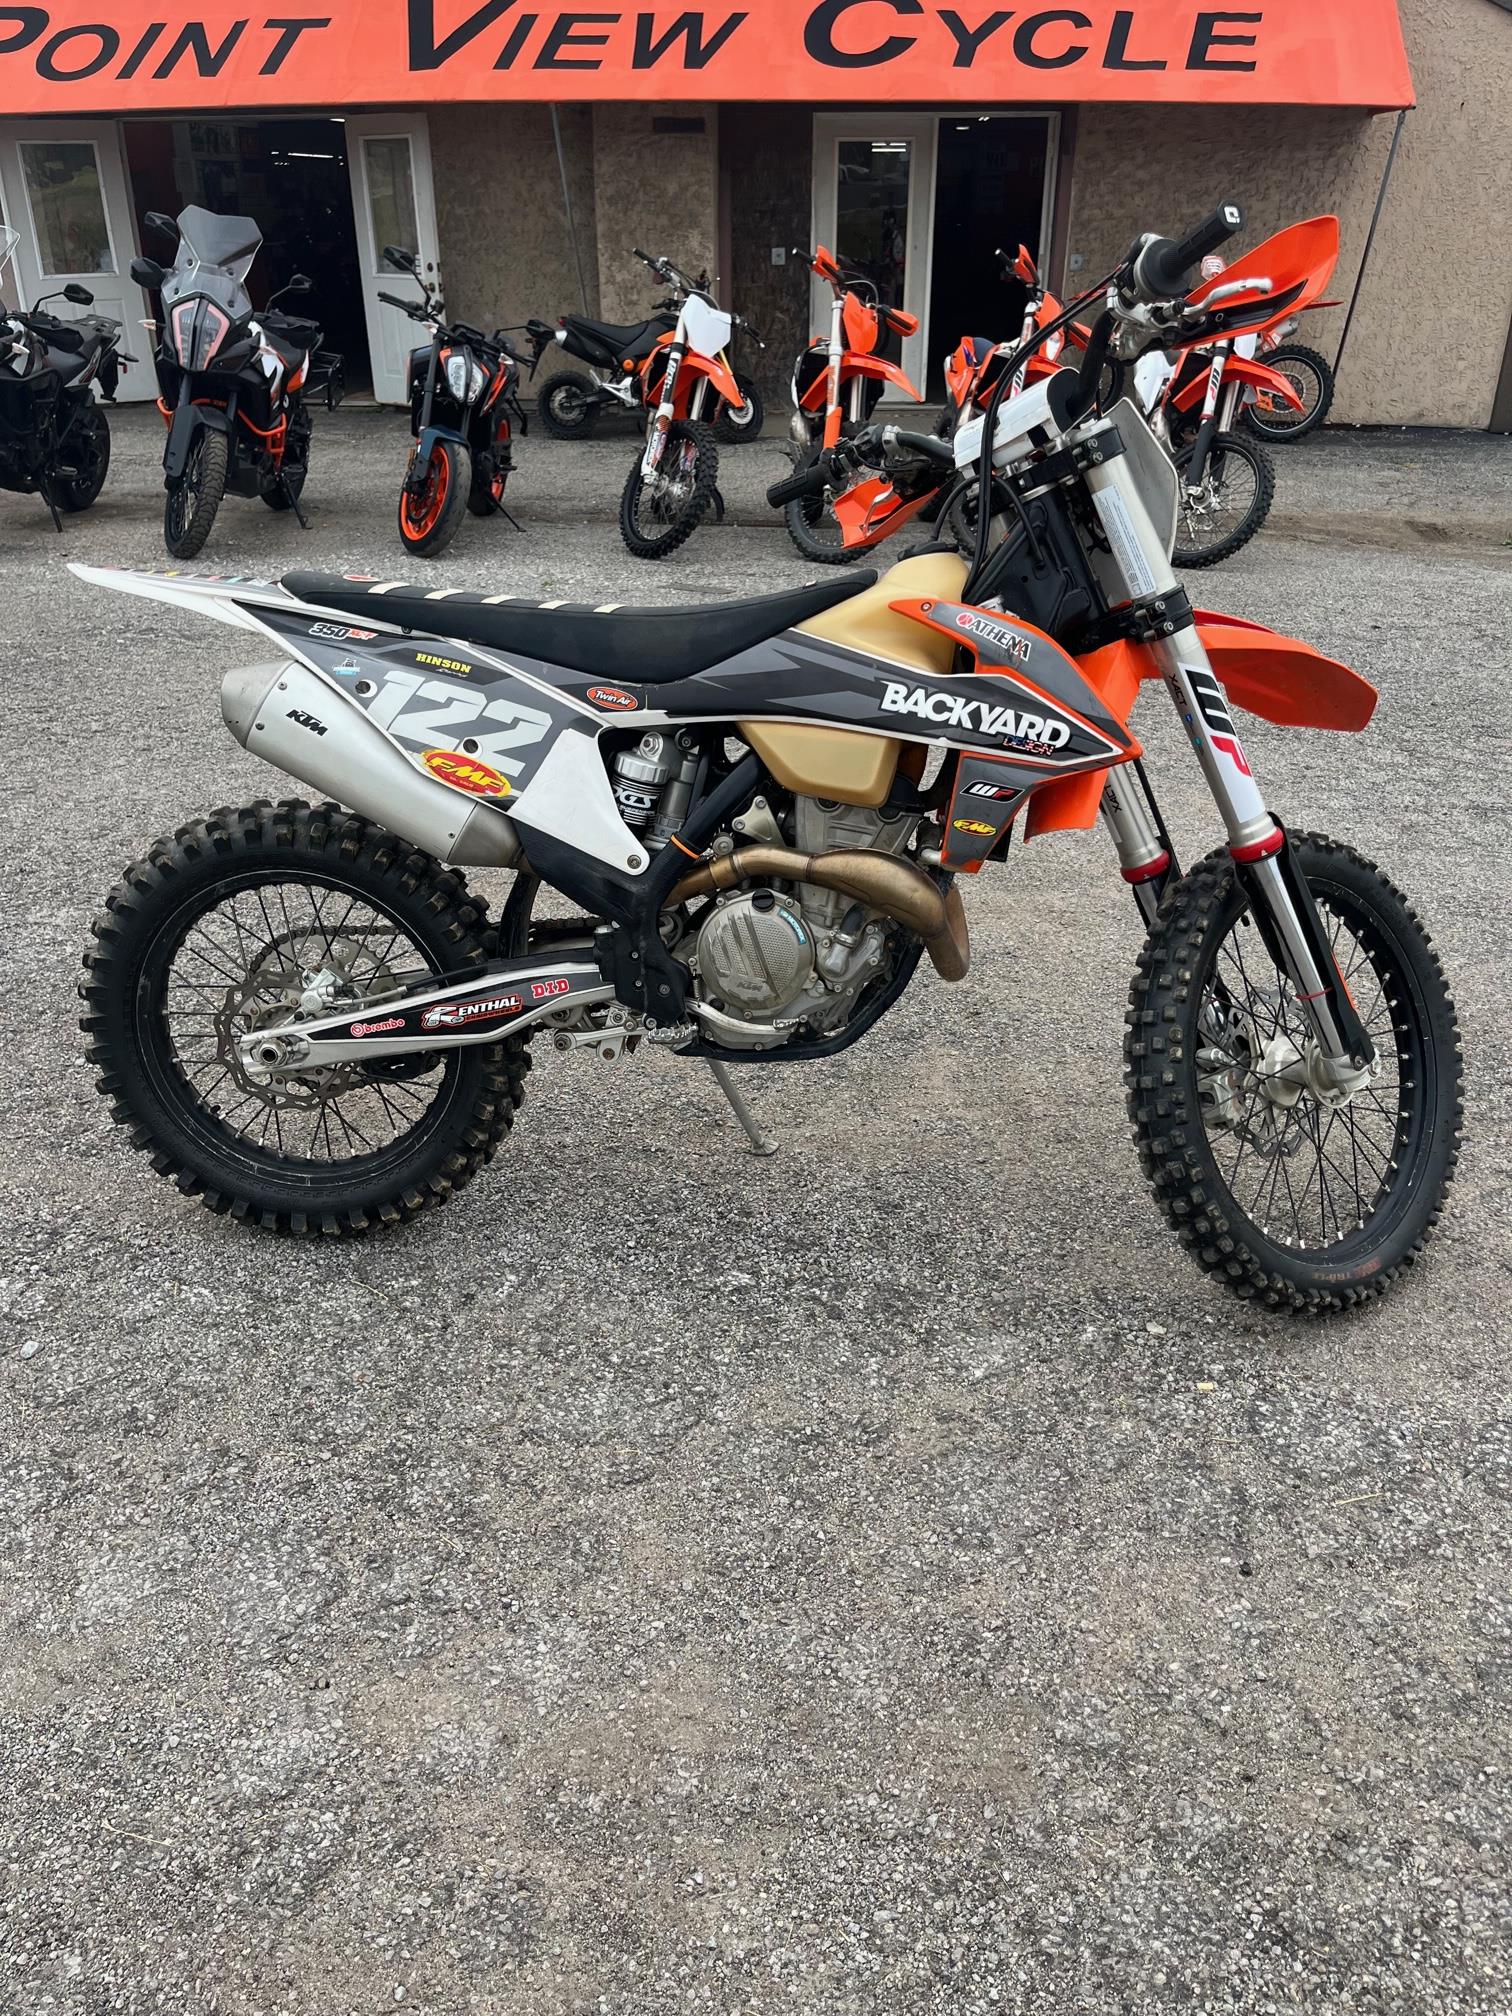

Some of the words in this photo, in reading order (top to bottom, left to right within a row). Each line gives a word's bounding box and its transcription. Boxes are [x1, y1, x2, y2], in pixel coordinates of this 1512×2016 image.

[408, 0, 746, 71] VIEW
[803, 0, 1263, 71] CYCLE
[309, 623, 350, 640] 350
[968, 615, 1031, 661] ATHENA
[416, 653, 472, 673] HINSON
[595, 690, 617, 702] Twin
[617, 696, 632, 706] Air
[1168, 673, 1188, 706] XACT
[286, 709, 328, 737] KTM
[366, 671, 553, 778] 122
[880, 680, 1071, 749] BACKYARD
[1185, 669, 1252, 778] WP
[426, 757, 504, 788] FMF
[968, 783, 1015, 799] WP
[364, 1019, 405, 1034] brembo
